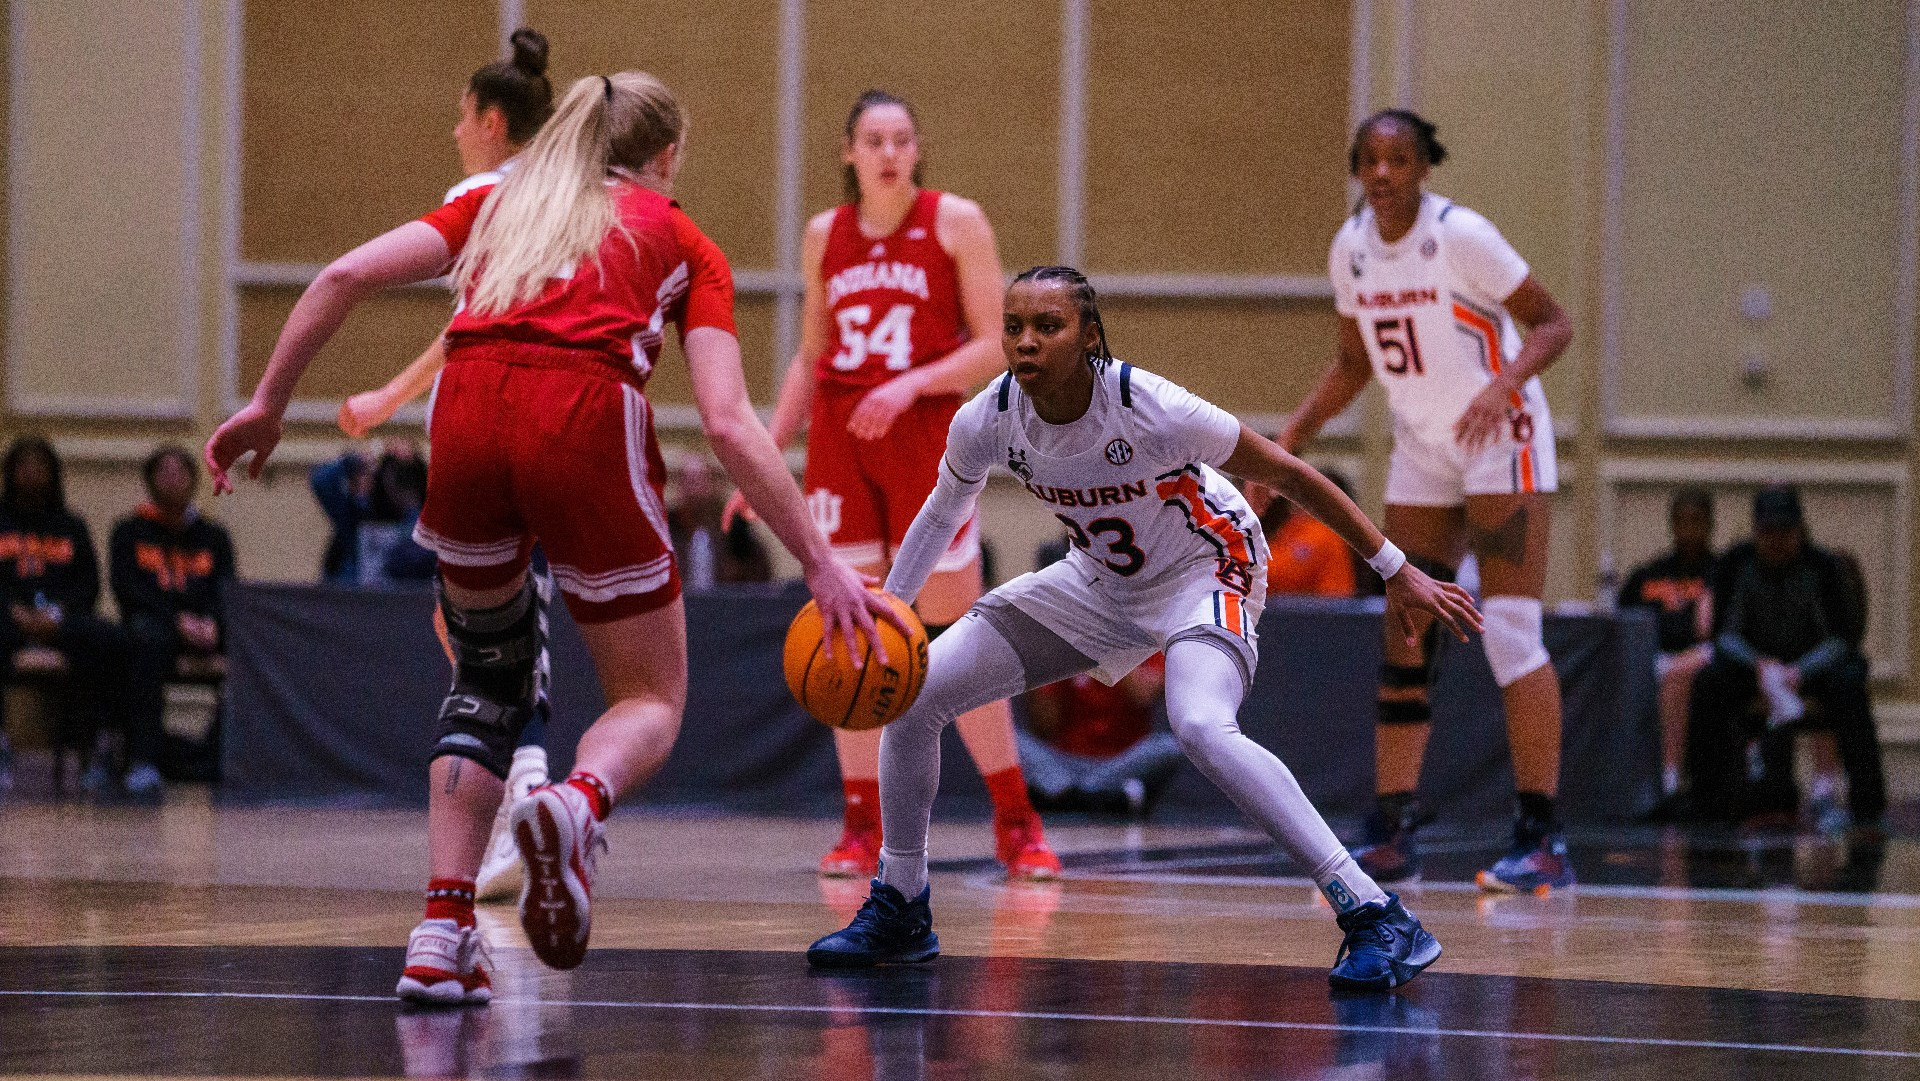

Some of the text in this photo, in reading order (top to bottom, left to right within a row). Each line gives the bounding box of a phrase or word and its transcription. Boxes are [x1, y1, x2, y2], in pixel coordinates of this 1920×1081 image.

[833, 304, 915, 371] 54
[1374, 316, 1424, 376] 51
[1106, 439, 1132, 465] SEC
